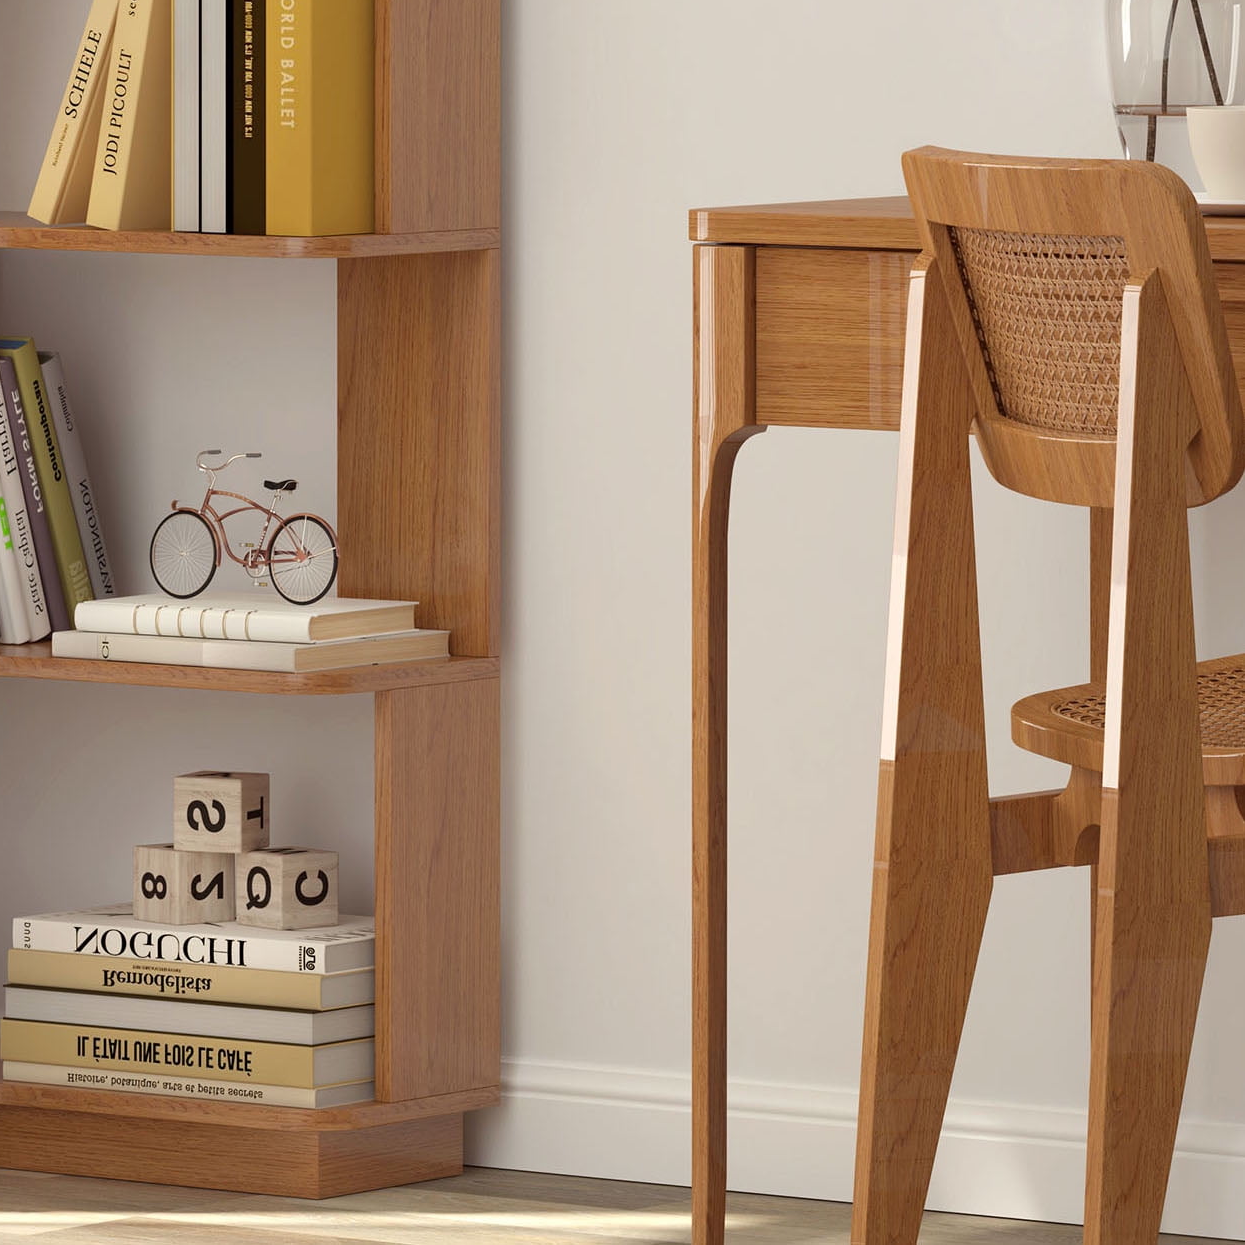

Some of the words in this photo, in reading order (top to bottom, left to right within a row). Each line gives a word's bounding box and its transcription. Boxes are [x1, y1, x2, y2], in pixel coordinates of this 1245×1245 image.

[64, 29, 102, 119] SCHIELE
[109, 48, 133, 129] PICOULT
[279, 59, 295, 128] BALLET
[102, 133, 121, 175] JODI
[295, 869, 329, 906] C
